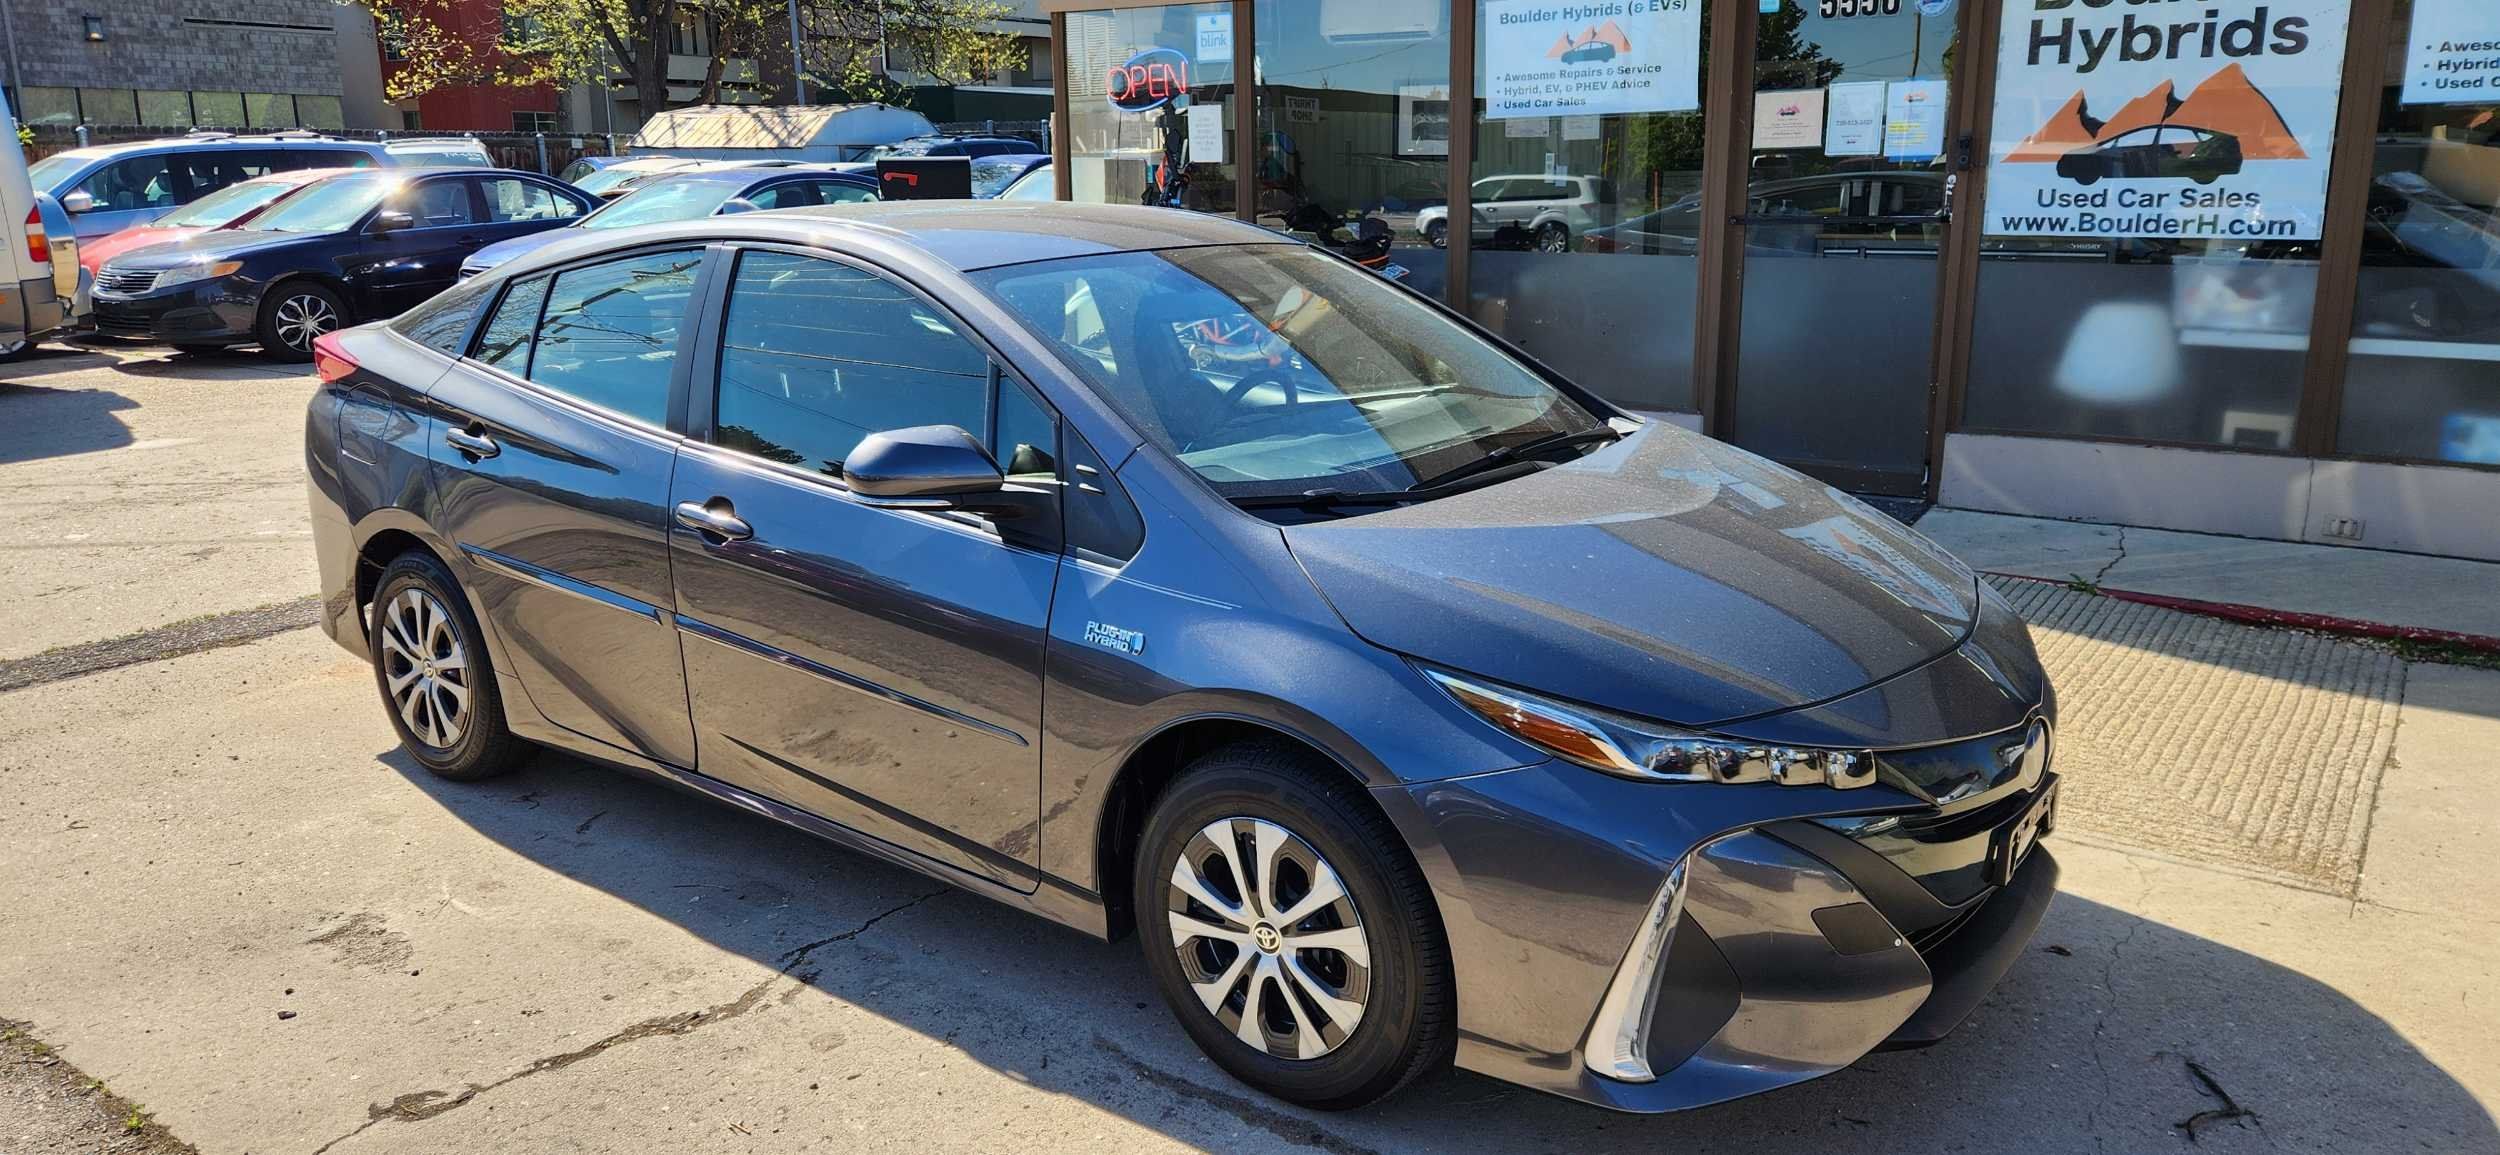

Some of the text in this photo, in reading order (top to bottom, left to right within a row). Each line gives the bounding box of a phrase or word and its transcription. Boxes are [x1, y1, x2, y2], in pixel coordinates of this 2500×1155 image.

[1500, 9, 1558, 25] Boulder
[1562, 3, 1622, 23] Hybrids
[1650, 0, 1687, 12] EVs)
[1201, 33, 1227, 48] blink
[2027, 6, 2310, 73] Hybrids
[1105, 60, 1188, 100] OPEN
[1504, 64, 1661, 82] Awesome Repairs & Service
[2435, 76, 2484, 89] Used
[1504, 79, 1650, 97] Hybrid, EV, & PHEV Advice
[1504, 97, 1586, 110] Used Car Sales
[2038, 187, 2261, 208] Used Car Sales
[2001, 213, 2297, 236] www.BoulderH.com
[1084, 629, 1130, 653] HYBRID
